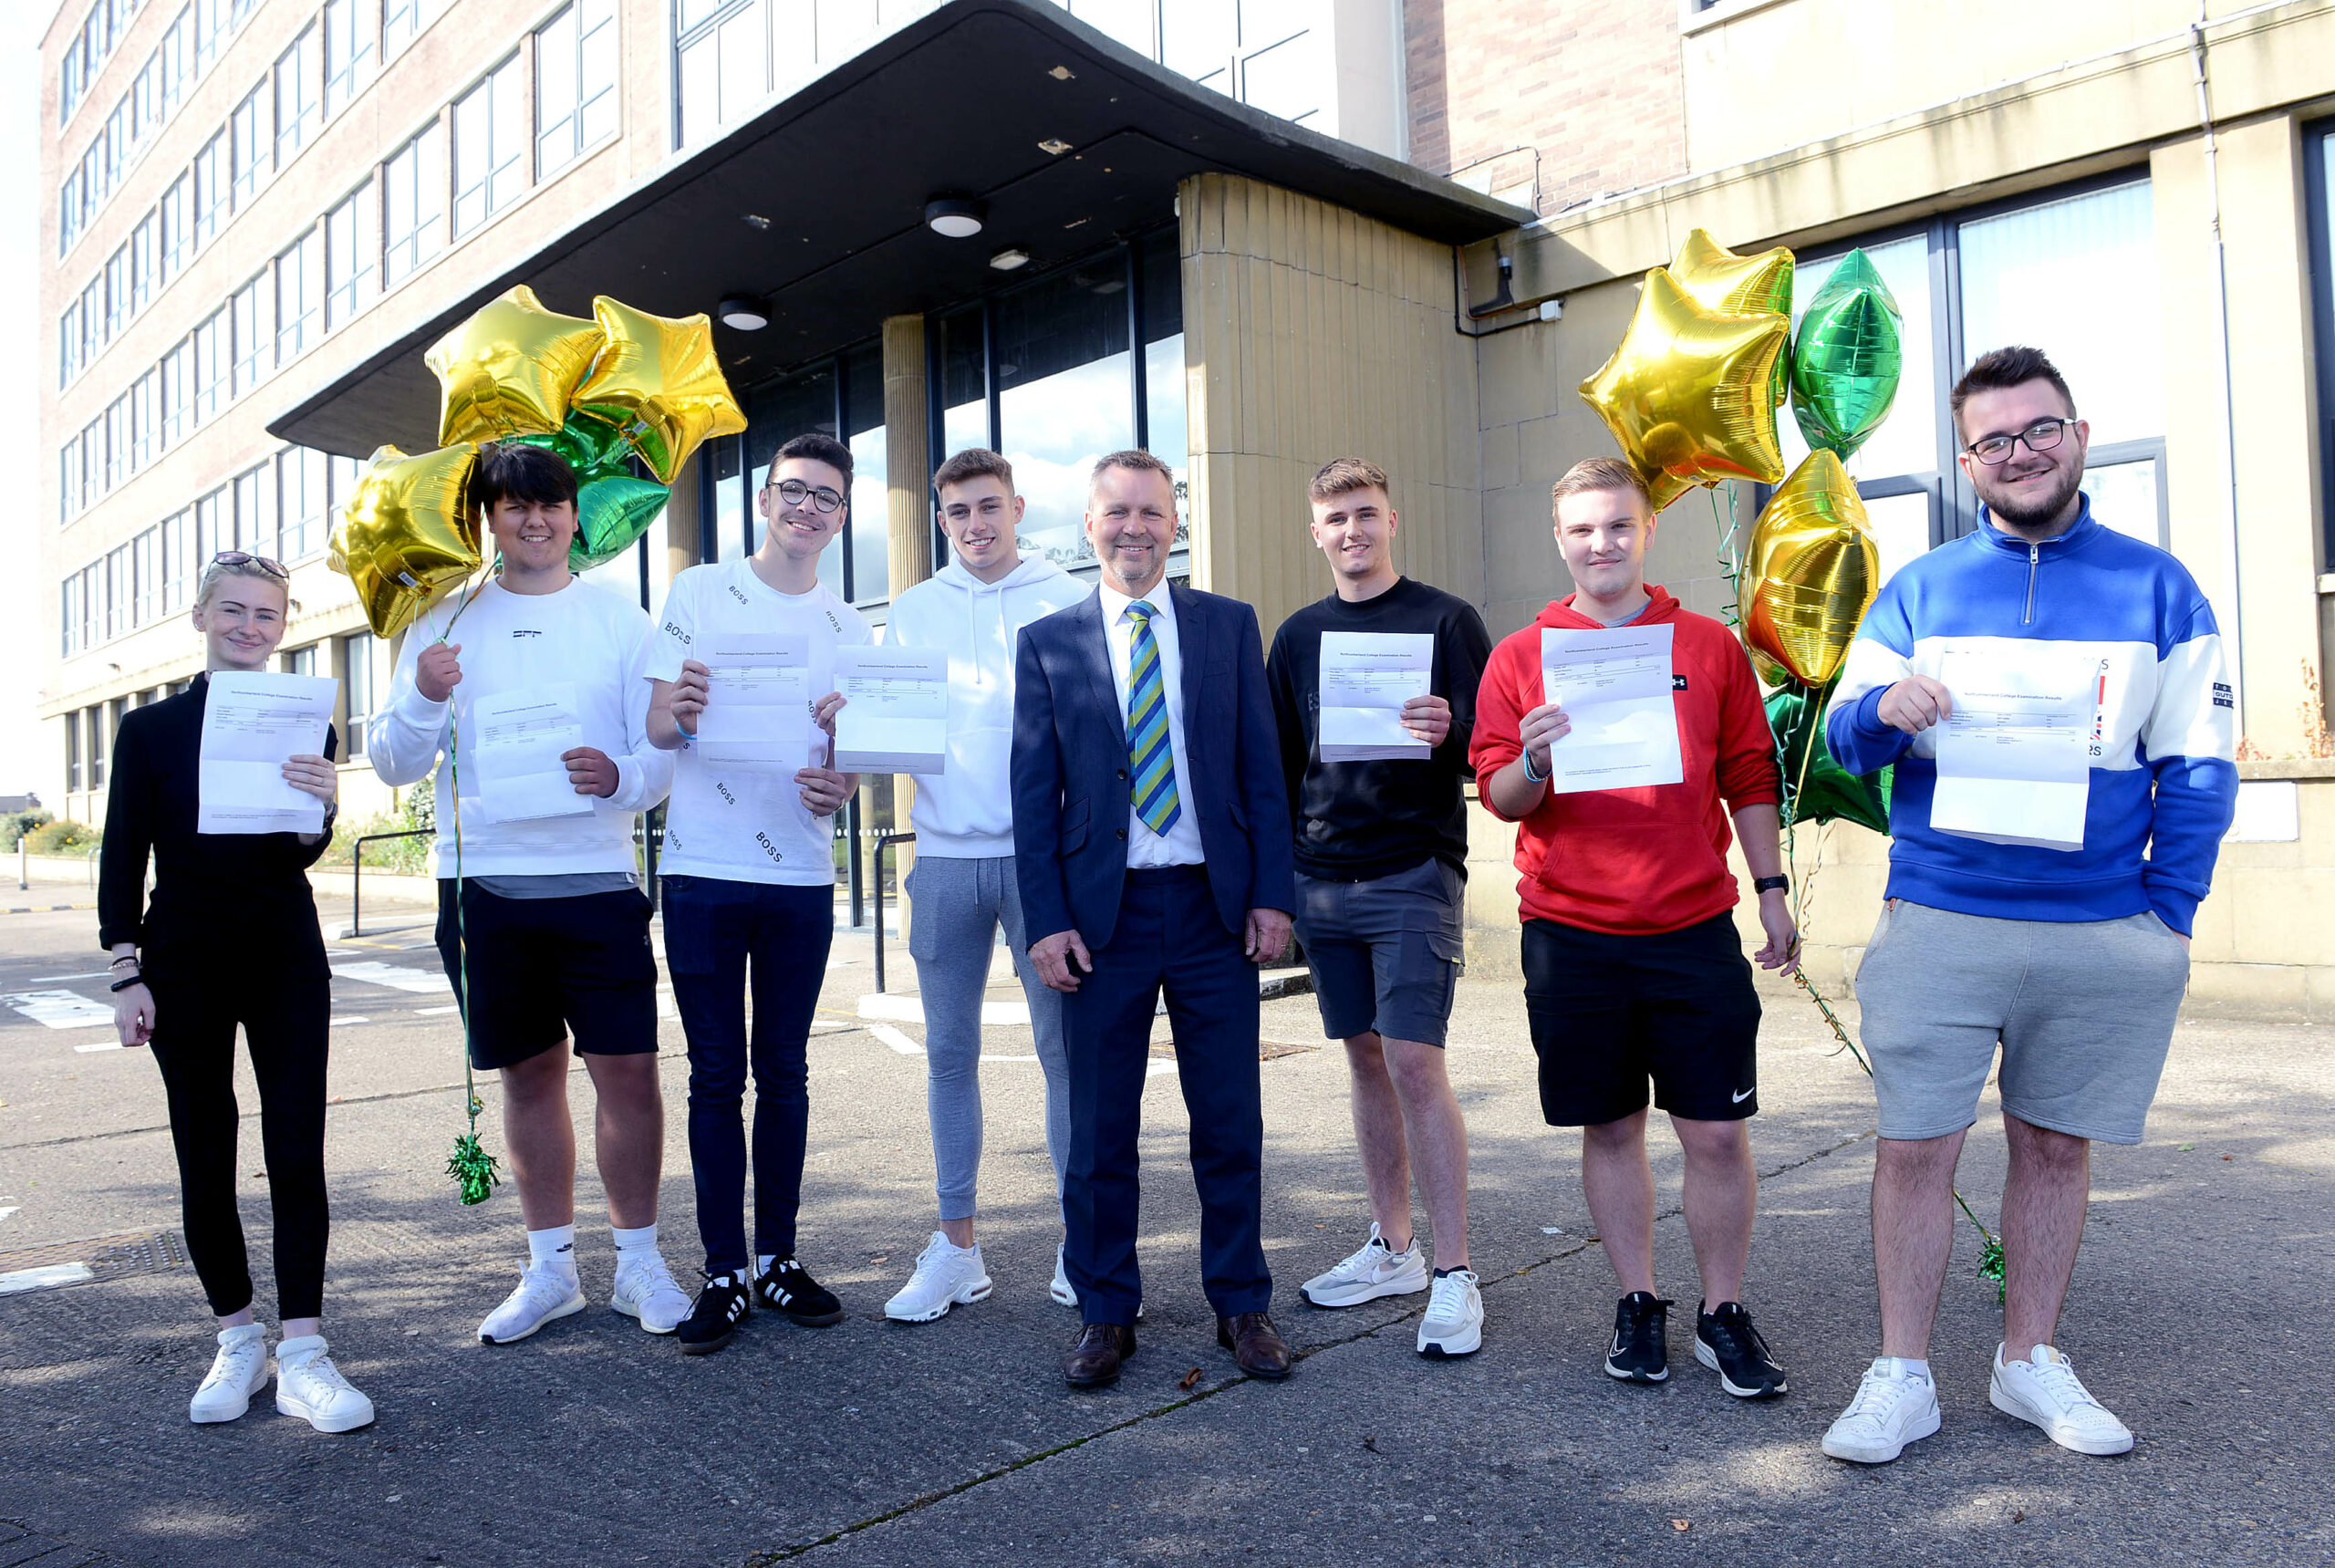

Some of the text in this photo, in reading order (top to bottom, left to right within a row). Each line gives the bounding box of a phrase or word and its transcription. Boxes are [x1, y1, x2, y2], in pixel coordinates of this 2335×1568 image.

[728, 585, 748, 605] BOSS
[665, 622, 691, 645] BOSS
[716, 782, 736, 805] BOSS
[755, 831, 783, 862] BOSS
